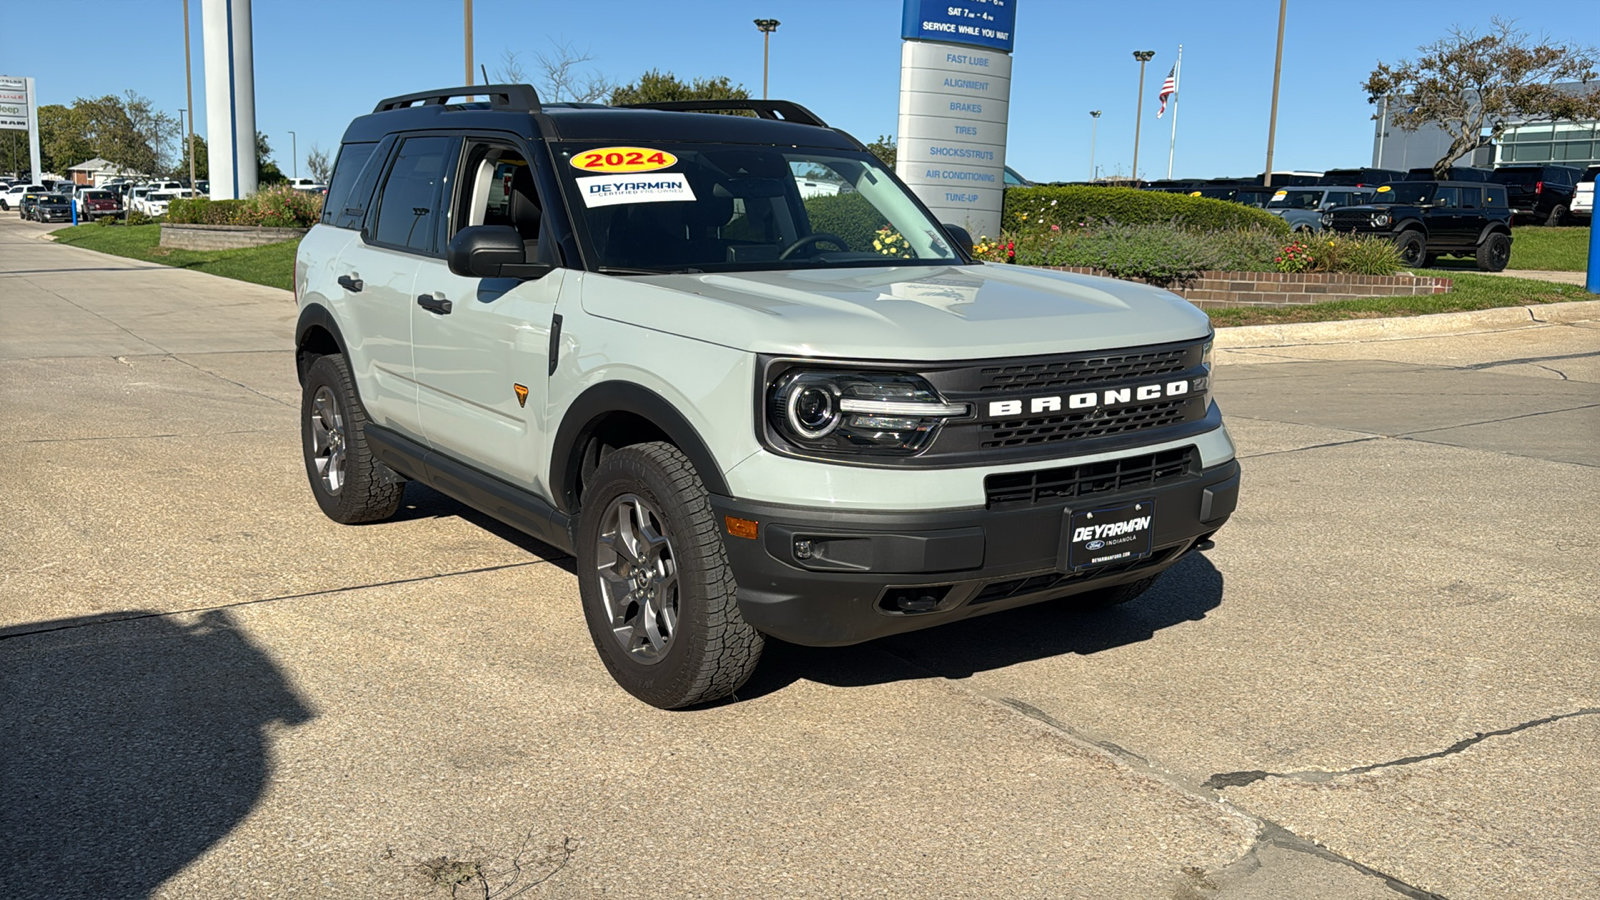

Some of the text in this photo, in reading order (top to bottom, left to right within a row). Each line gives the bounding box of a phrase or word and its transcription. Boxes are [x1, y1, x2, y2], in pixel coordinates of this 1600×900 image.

[947, 6, 962, 16] SAT
[922, 21, 1009, 40] SERVICE WHILE YOU WAIT
[946, 53, 989, 67] FAST LUBE
[943, 78, 989, 91] ALIGNMENT
[949, 102, 982, 113] BRAKES
[954, 126, 977, 136] TIRES
[584, 152, 667, 168] 2024
[929, 146, 994, 161] SHOCKS/STRUTS
[926, 170, 995, 182] AIR CONDITIONING
[589, 181, 682, 194] DEYARMAN
[945, 192, 979, 202] TUNE-UP
[988, 379, 1189, 417] BRONCO
[1072, 515, 1151, 543] DEYARMAN
[1106, 534, 1137, 546] INDIANOLA
